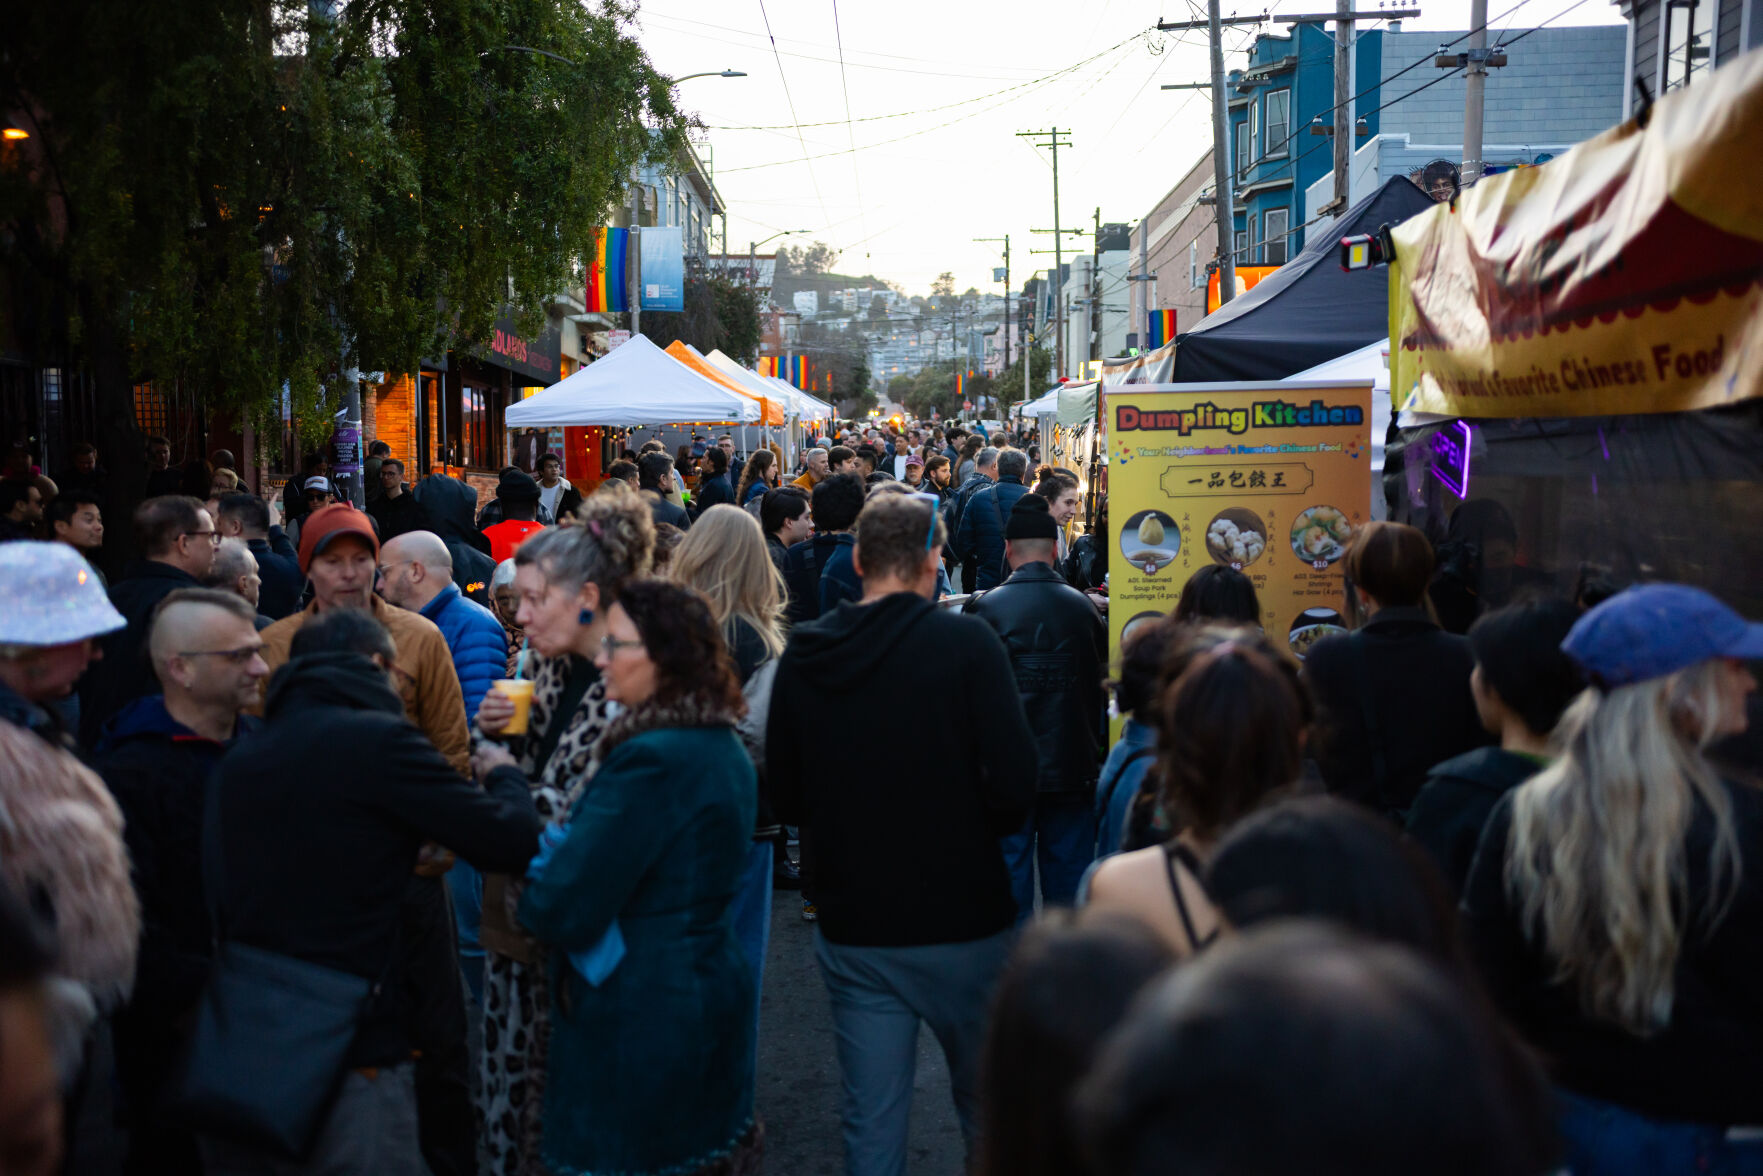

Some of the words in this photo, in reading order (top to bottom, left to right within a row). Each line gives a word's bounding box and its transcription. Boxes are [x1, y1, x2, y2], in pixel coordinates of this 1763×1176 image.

[1560, 356, 1647, 392] Chinese
[1652, 334, 1725, 382] Food
[1116, 400, 1249, 436] Dumpling
[1252, 398, 1363, 429] Kitchen
[1137, 446, 1161, 457] Your
[1238, 443, 1279, 455] Favorite
[1280, 442, 1317, 453] Chinese
[1319, 442, 1342, 452] Food
[1188, 470, 1287, 488] 一品包餃王
[1313, 560, 1328, 568] $10
